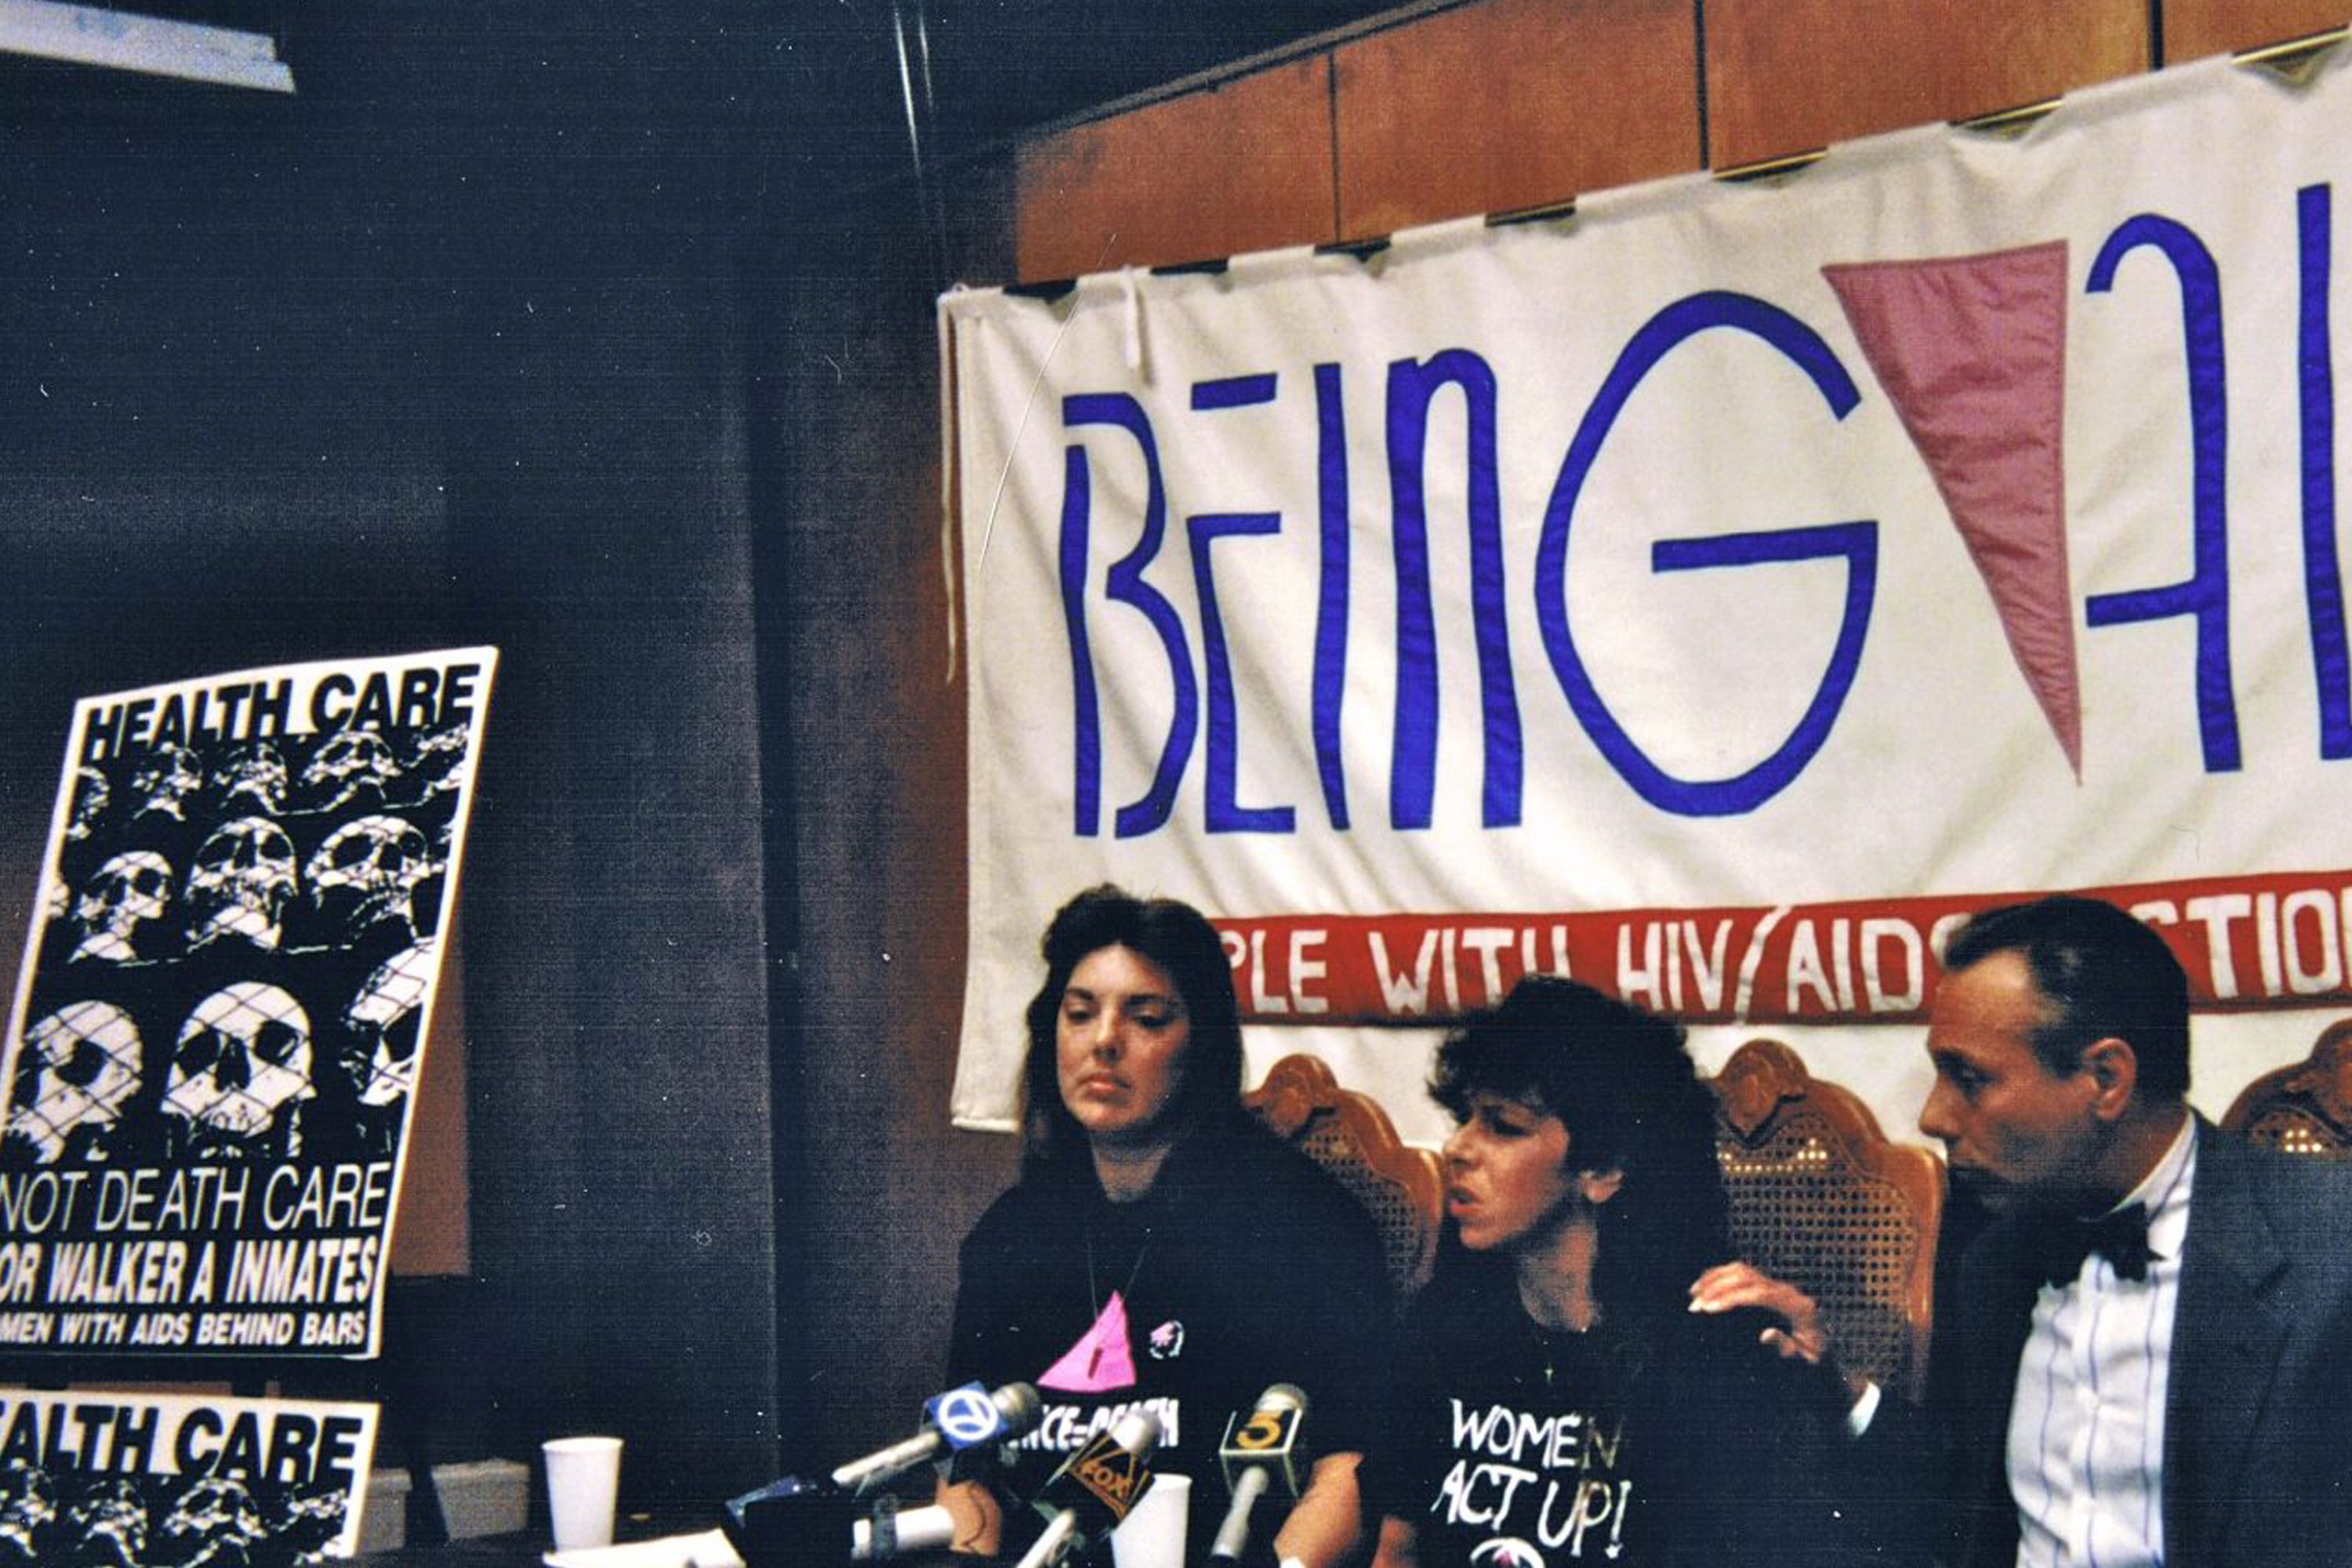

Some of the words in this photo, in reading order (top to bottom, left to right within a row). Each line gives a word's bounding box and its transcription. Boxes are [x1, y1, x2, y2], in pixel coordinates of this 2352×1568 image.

[84, 678, 293, 760] HEALTH
[310, 663, 481, 732] CARE
[1368, 925, 1572, 1015] WITH
[2130, 886, 2352, 999] TIO
[0, 1171, 89, 1233] NOT
[95, 1167, 249, 1232] DEATH
[263, 1162, 391, 1231] CARE
[48, 1241, 188, 1303] WALKER
[189, 1240, 215, 1303] A
[225, 1236, 378, 1303] INMATES
[59, 1312, 127, 1345] WITH
[130, 1312, 192, 1345] AIDS
[195, 1312, 296, 1345] BEHIND
[299, 1311, 366, 1345] BARS
[0, 1400, 160, 1474] ALTH
[175, 1406, 363, 1484] CARE
[1236, 1411, 1281, 1450] 5
[1450, 1398, 1624, 1469] WOMEN
[1076, 1459, 1132, 1500] FOX
[1430, 1459, 1538, 1531] ACT
[1537, 1479, 1632, 1559] UP!
